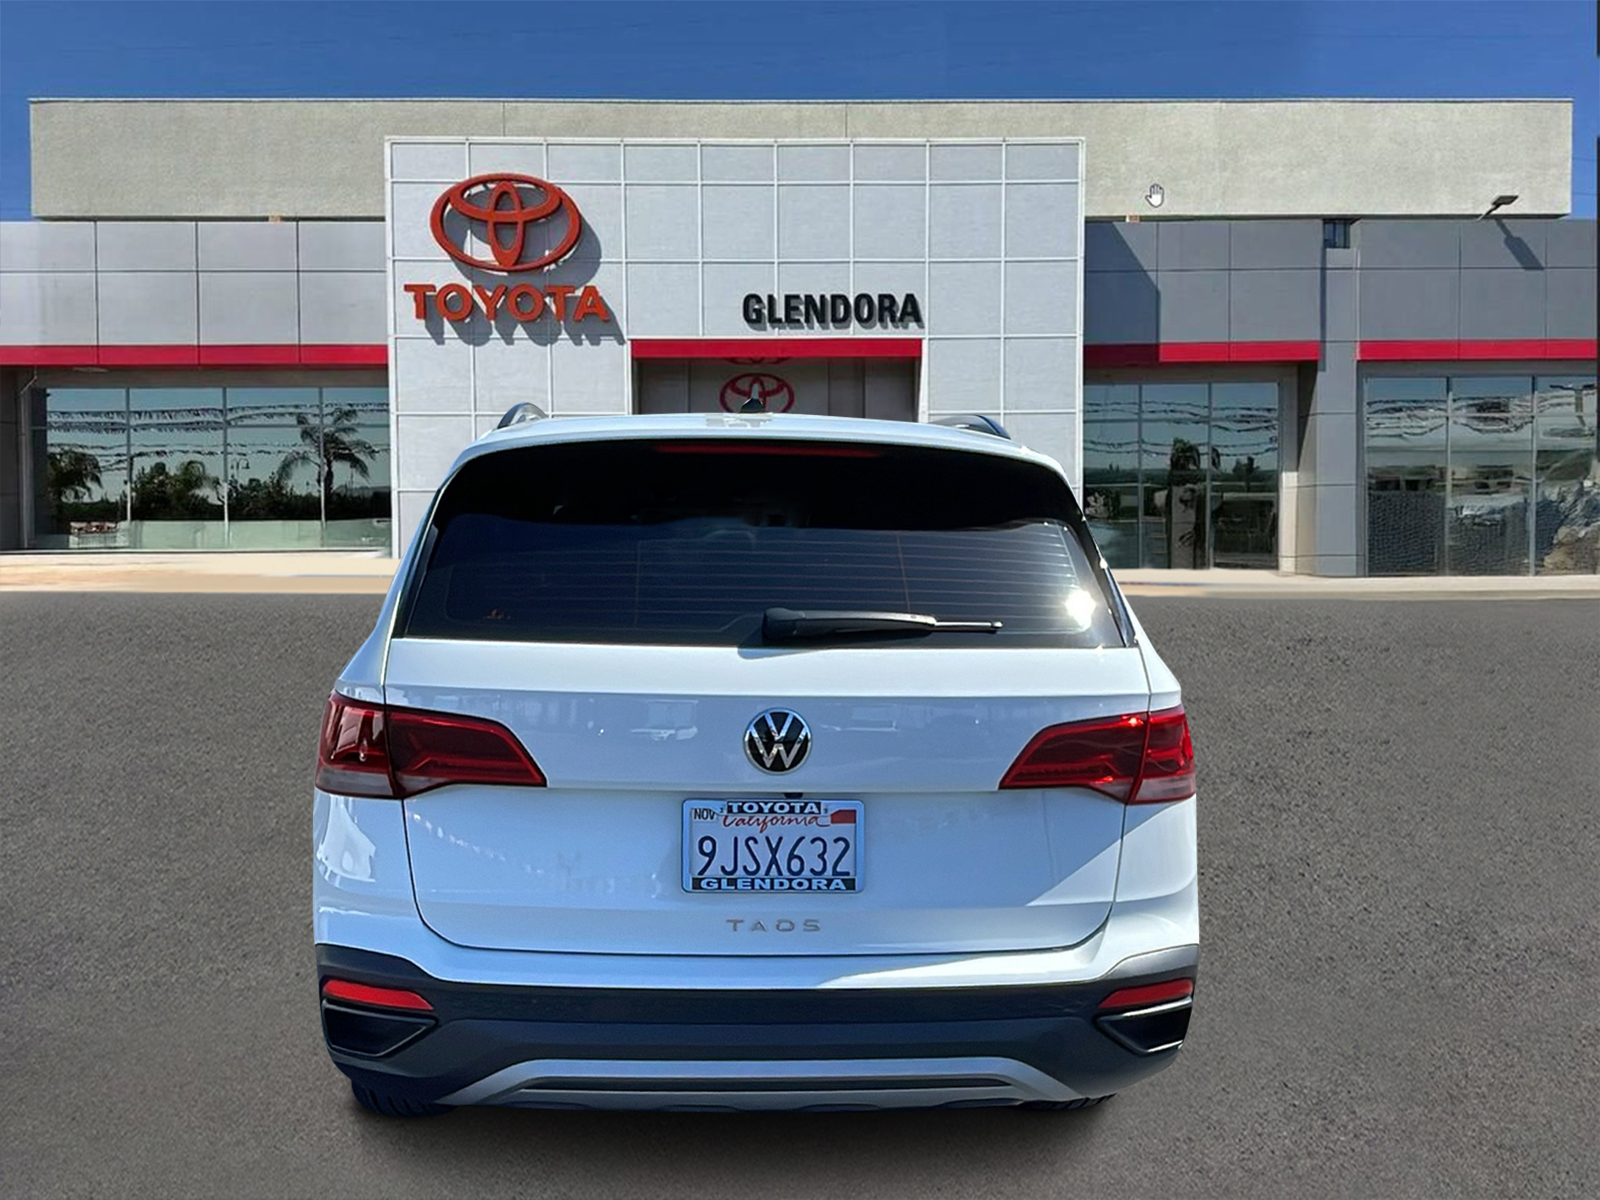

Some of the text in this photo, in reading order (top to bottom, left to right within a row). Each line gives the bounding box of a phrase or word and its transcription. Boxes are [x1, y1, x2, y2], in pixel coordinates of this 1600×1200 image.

[404, 283, 611, 324] TOYOTA
[742, 292, 922, 325] GLENDORA
[728, 802, 820, 814] TOYOTA
[697, 835, 850, 876] 9JSX632
[700, 878, 846, 890] GLENDORA
[726, 919, 821, 932] TAOS
